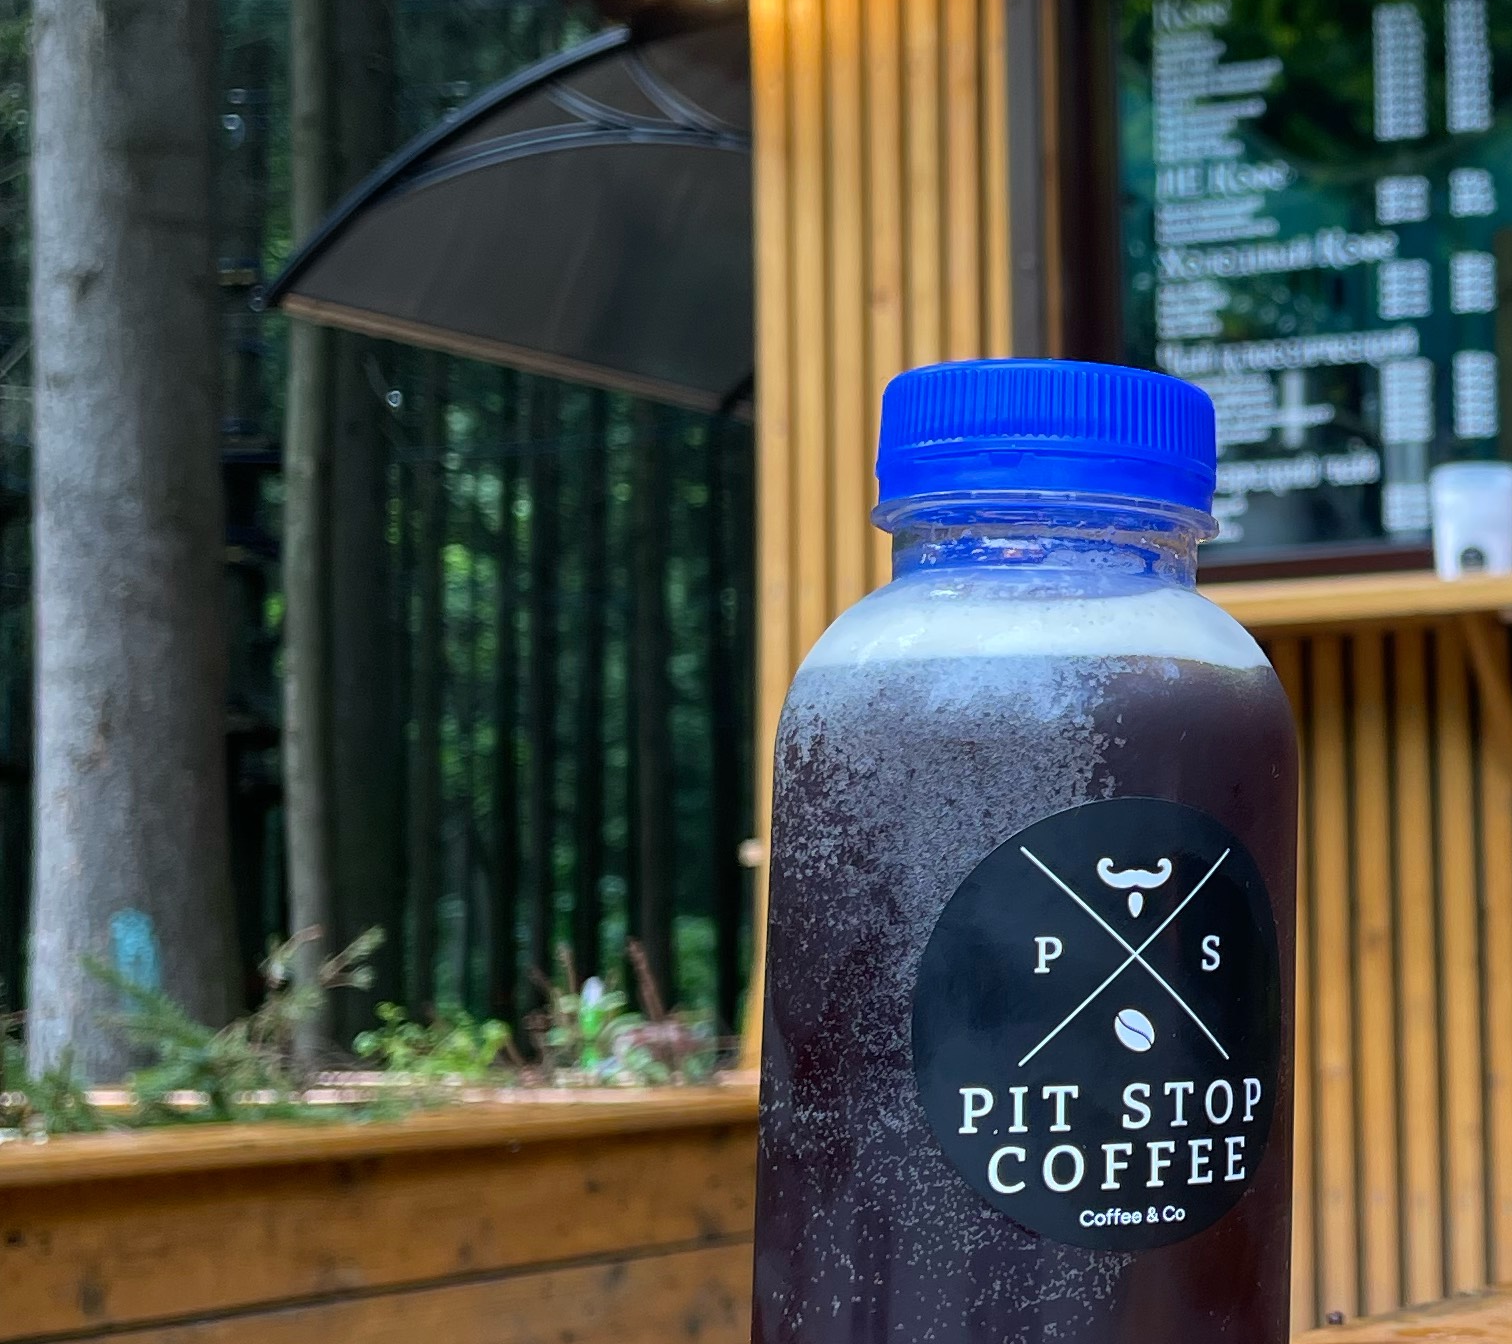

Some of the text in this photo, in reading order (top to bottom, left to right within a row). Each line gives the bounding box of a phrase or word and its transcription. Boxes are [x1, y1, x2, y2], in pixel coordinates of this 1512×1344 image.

[1033, 934, 1221, 974] P S
[958, 1077, 1262, 1134] PIT STOP
[987, 1136, 1246, 1194] COFFEE
[1079, 1206, 1186, 1228] Coffee & Co
